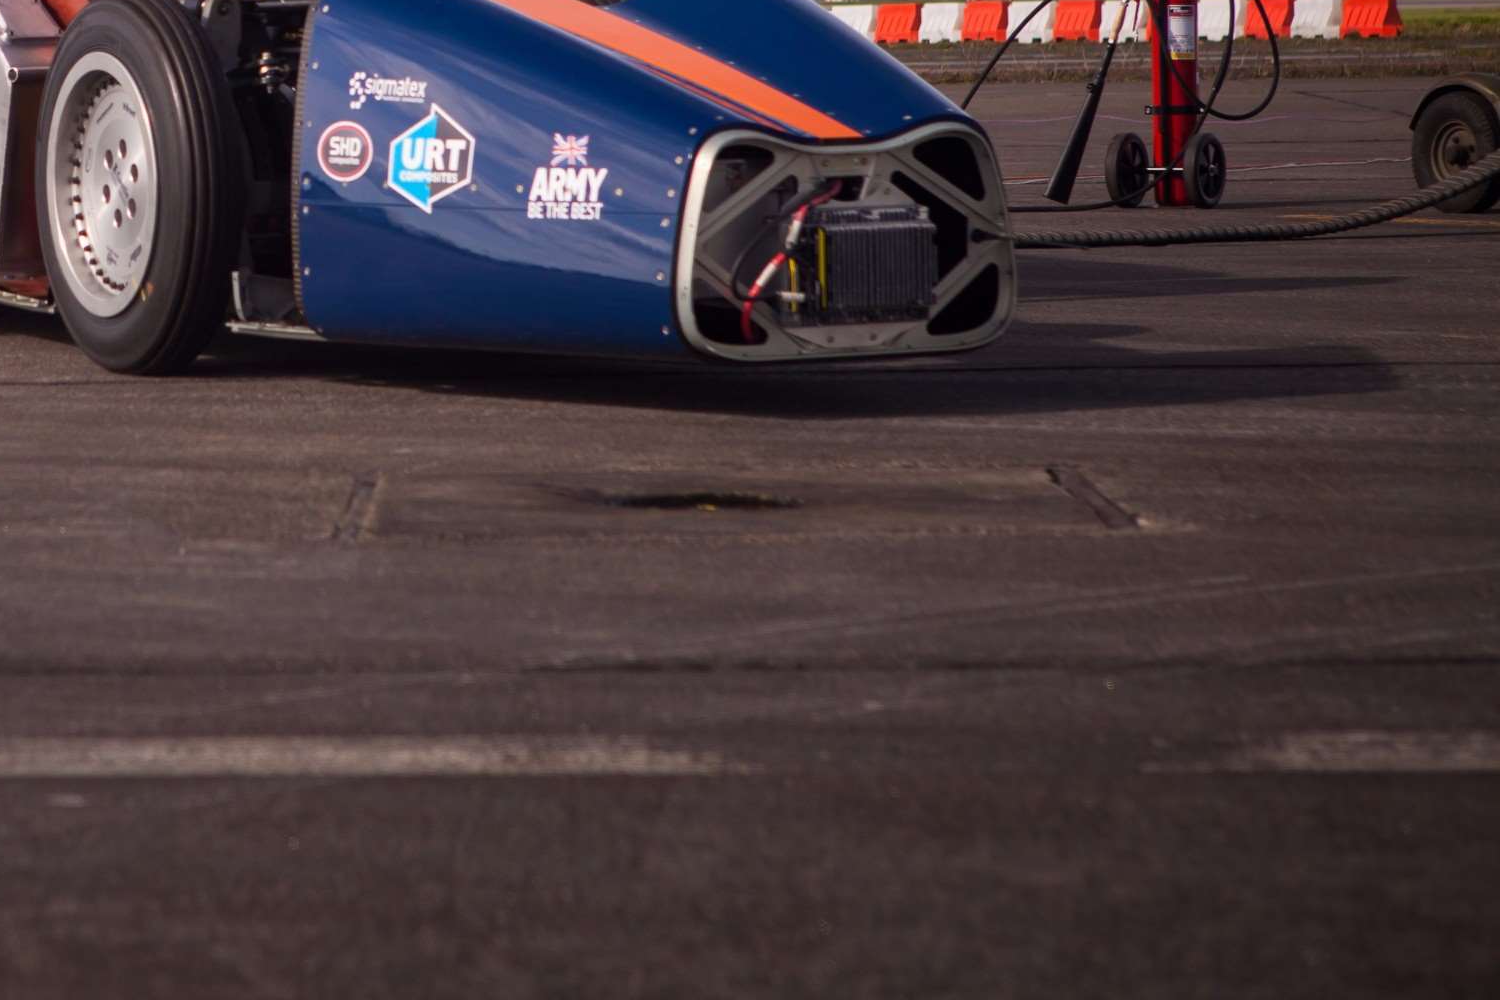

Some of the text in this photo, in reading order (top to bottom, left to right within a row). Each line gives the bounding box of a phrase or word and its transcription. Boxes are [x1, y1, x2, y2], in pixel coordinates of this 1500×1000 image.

[365, 73, 427, 101] sigmatex
[329, 136, 362, 157] SHD
[401, 137, 467, 171] URT
[528, 166, 609, 202] ARMY
[527, 202, 604, 220] BE THE BEST
